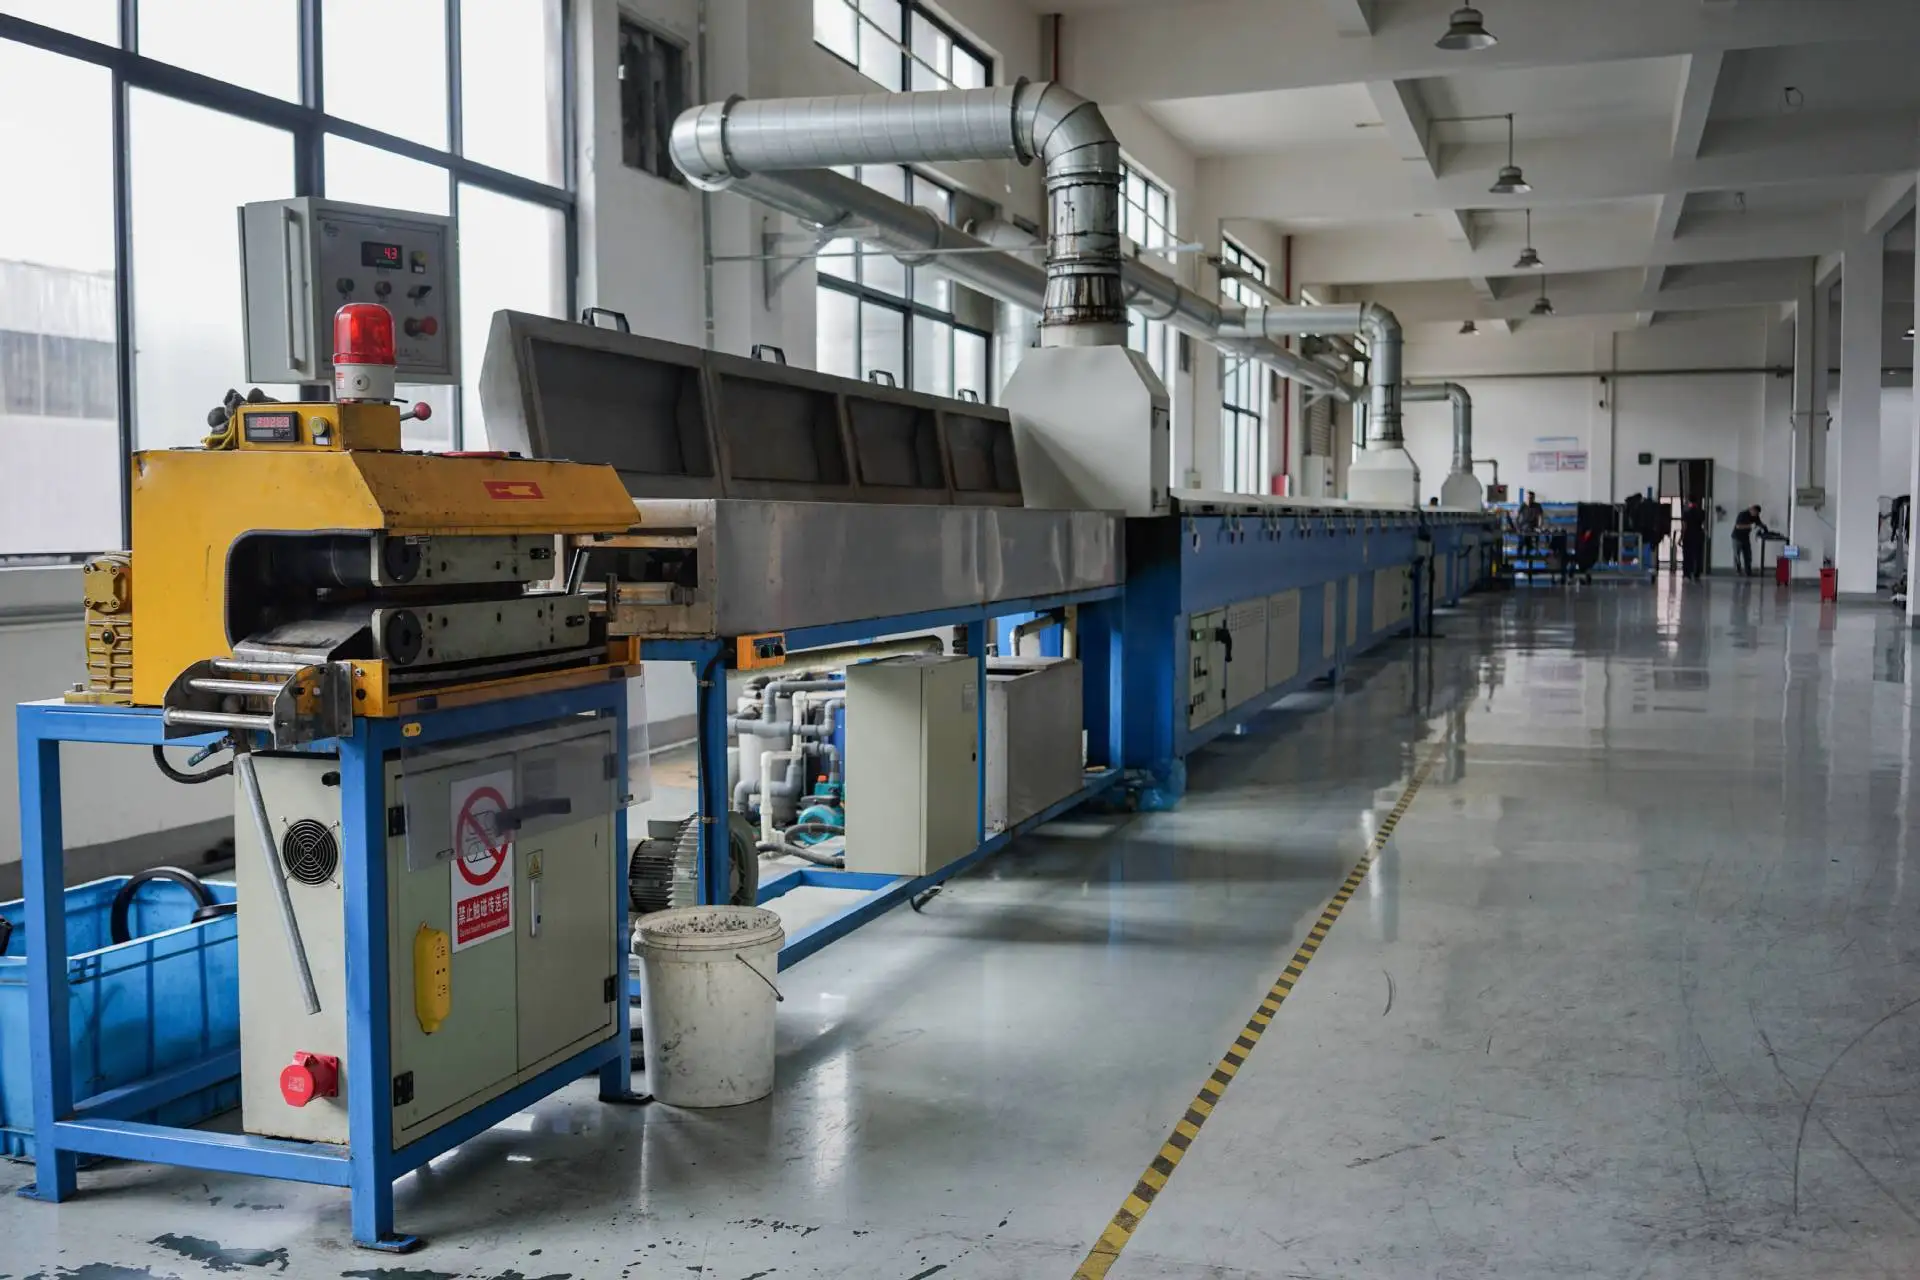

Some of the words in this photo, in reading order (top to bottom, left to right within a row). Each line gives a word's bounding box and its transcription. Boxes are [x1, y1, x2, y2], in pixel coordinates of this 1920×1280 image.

[458, 891, 508, 925] 禁止触碰传送带
